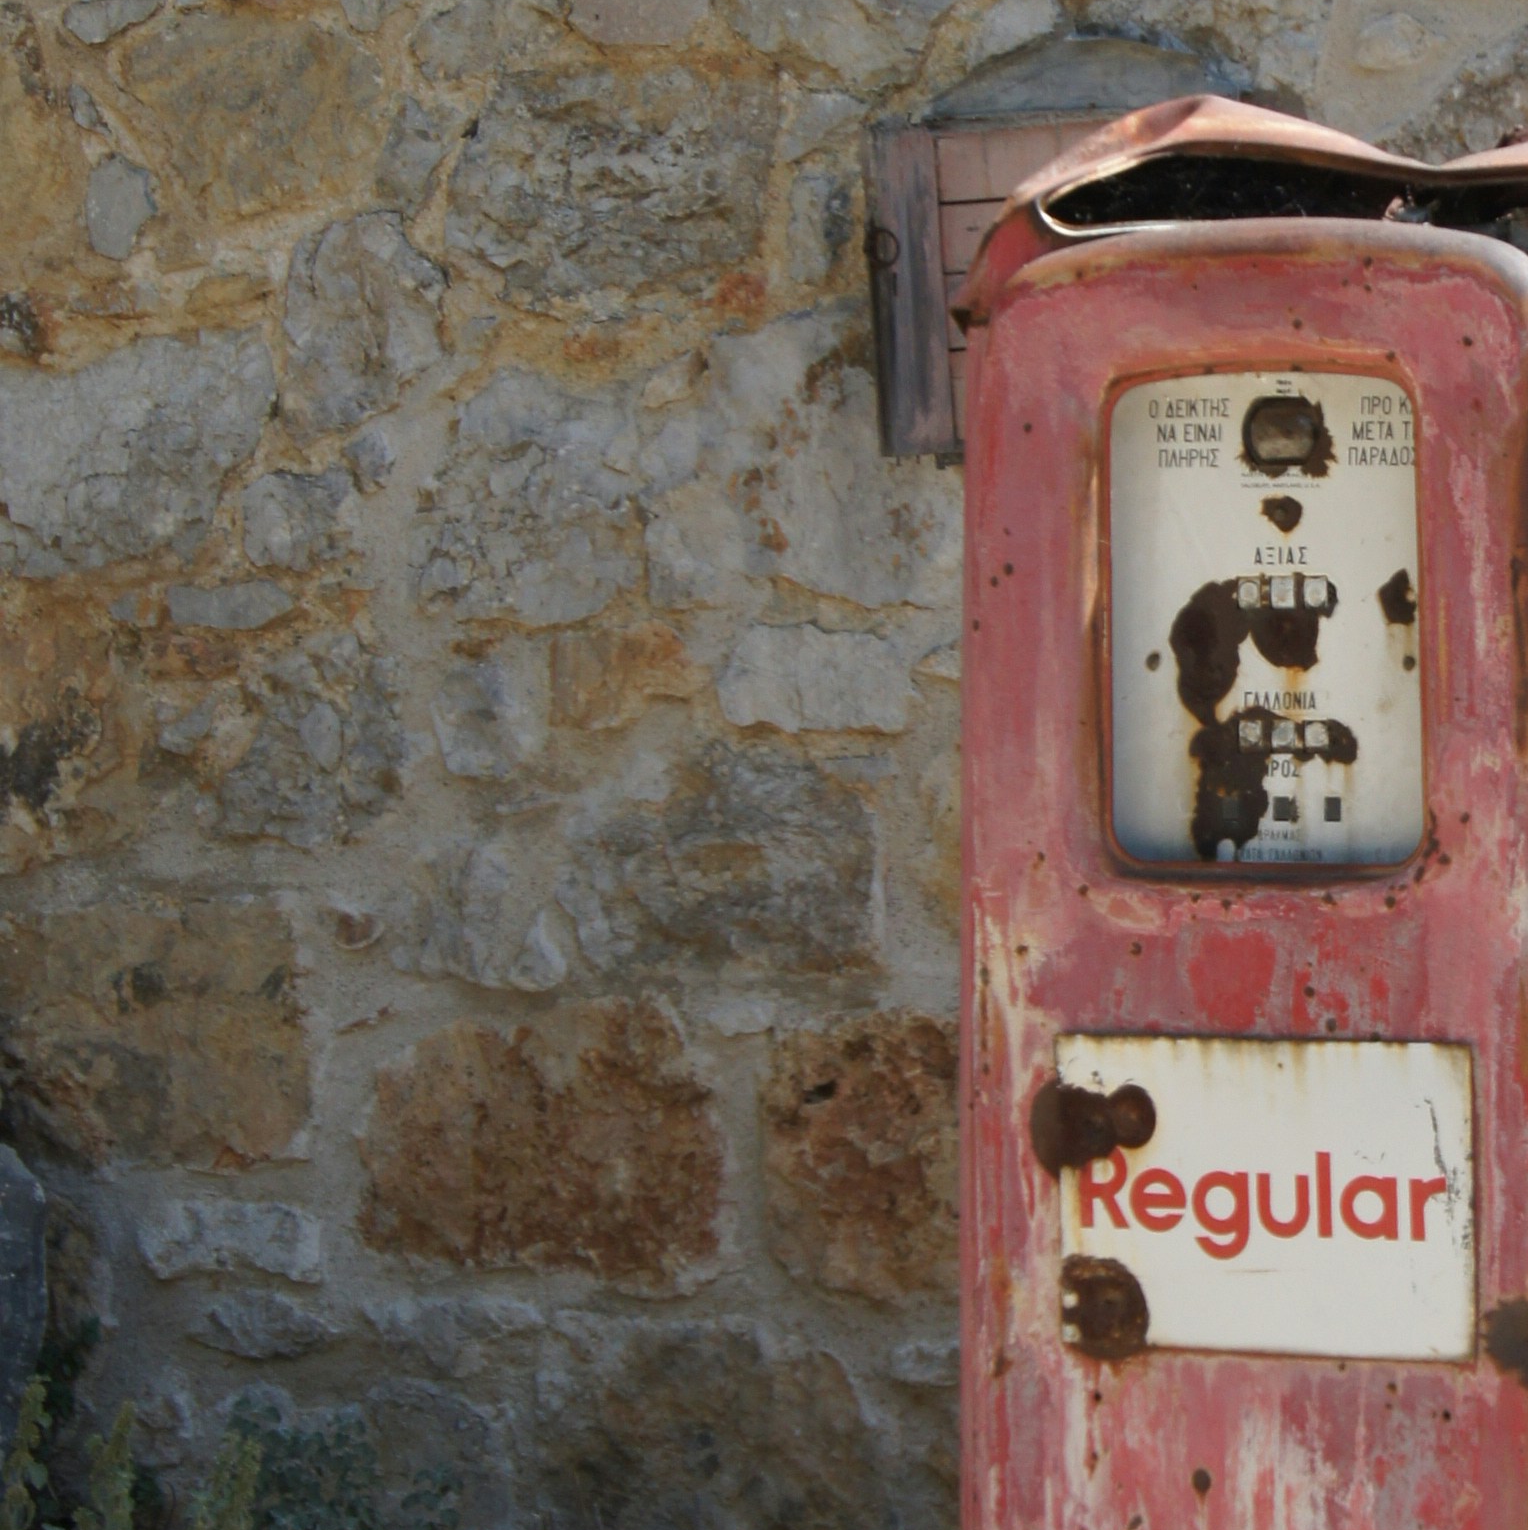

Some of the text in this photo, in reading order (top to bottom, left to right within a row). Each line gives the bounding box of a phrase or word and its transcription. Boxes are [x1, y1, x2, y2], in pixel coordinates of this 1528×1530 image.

[1148, 397, 1230, 419] Ο ΔΕΙΚΤΗΣ
[1360, 395, 1392, 416] ΠΡΟ
[1156, 422, 1223, 443] ΝΑ ΕΙΝΑΙ
[1351, 420, 1394, 441] ΜΕΤΑ
[1158, 448, 1220, 468] ΠΛΗΡΗΣ
[1254, 546, 1308, 565] ΑΞΙΑΣ
[1244, 691, 1317, 710] ΓΑΛΛΟΝΙΑ
[1266, 758, 1300, 778] ΡΟΣ
[1079, 1147, 1447, 1259] Regular
